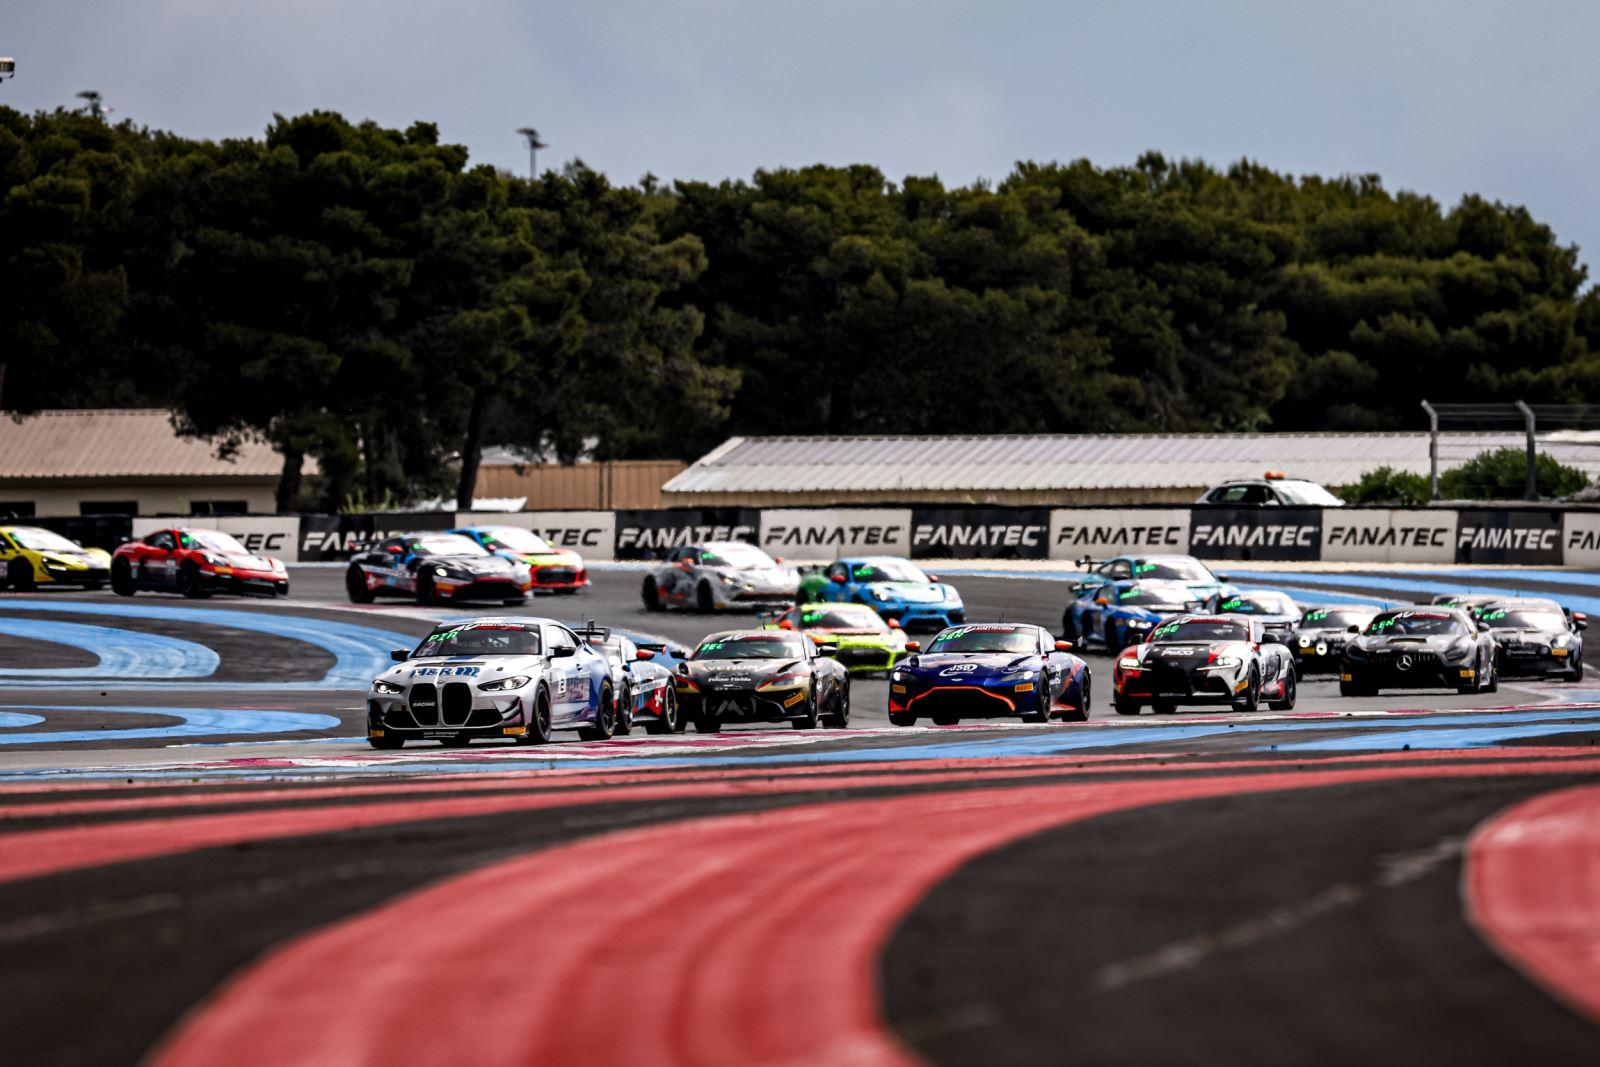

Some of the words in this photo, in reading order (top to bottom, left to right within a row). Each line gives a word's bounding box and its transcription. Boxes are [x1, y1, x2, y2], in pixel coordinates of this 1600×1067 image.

[618, 526, 755, 549] FANATEC
[765, 525, 900, 545] FANATEC
[913, 525, 1041, 546] FANATEC
[1057, 526, 1181, 545] FANATEC
[1192, 525, 1315, 546] FANATEC
[1328, 526, 1449, 546] FANATEC
[1458, 527, 1557, 549] FANATEC
